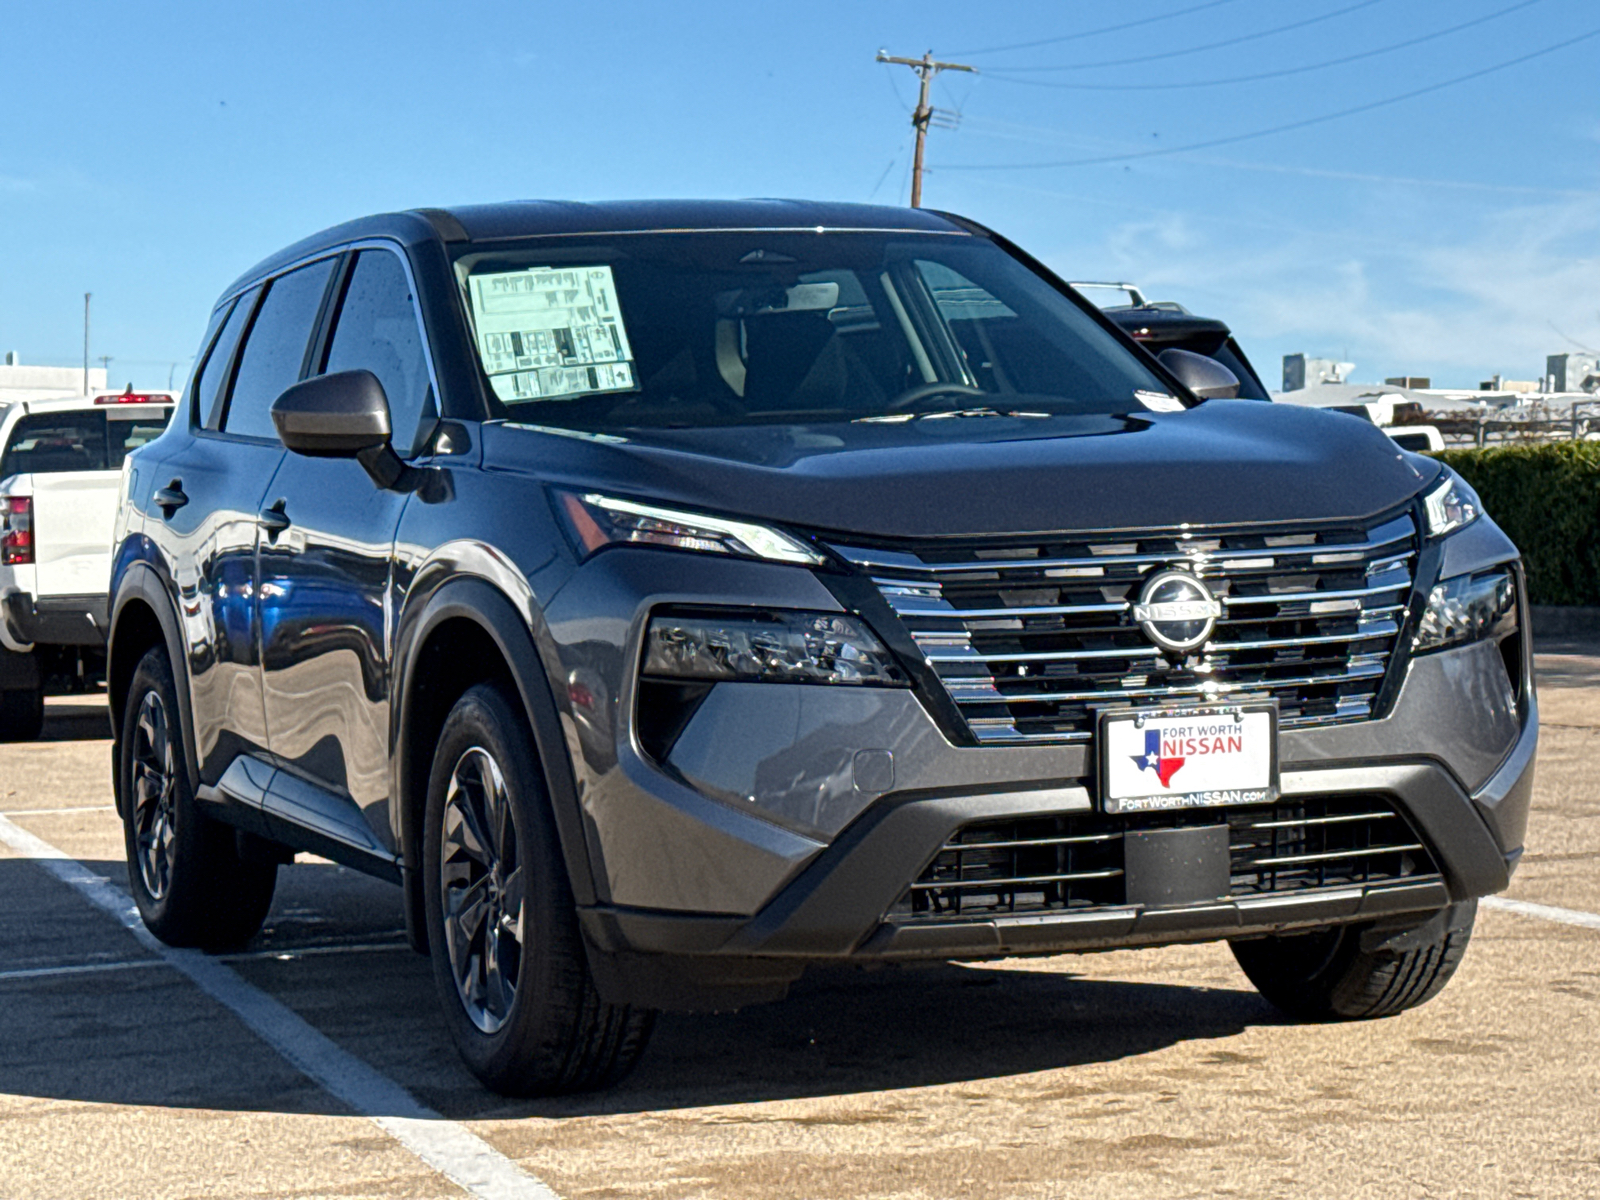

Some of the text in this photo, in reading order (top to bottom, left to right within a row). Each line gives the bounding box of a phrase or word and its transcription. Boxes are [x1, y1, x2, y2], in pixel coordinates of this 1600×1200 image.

[1135, 602, 1220, 619] NISSAN
[1163, 724, 1242, 738] FORT WORTH
[1163, 736, 1242, 756] NISSAN
